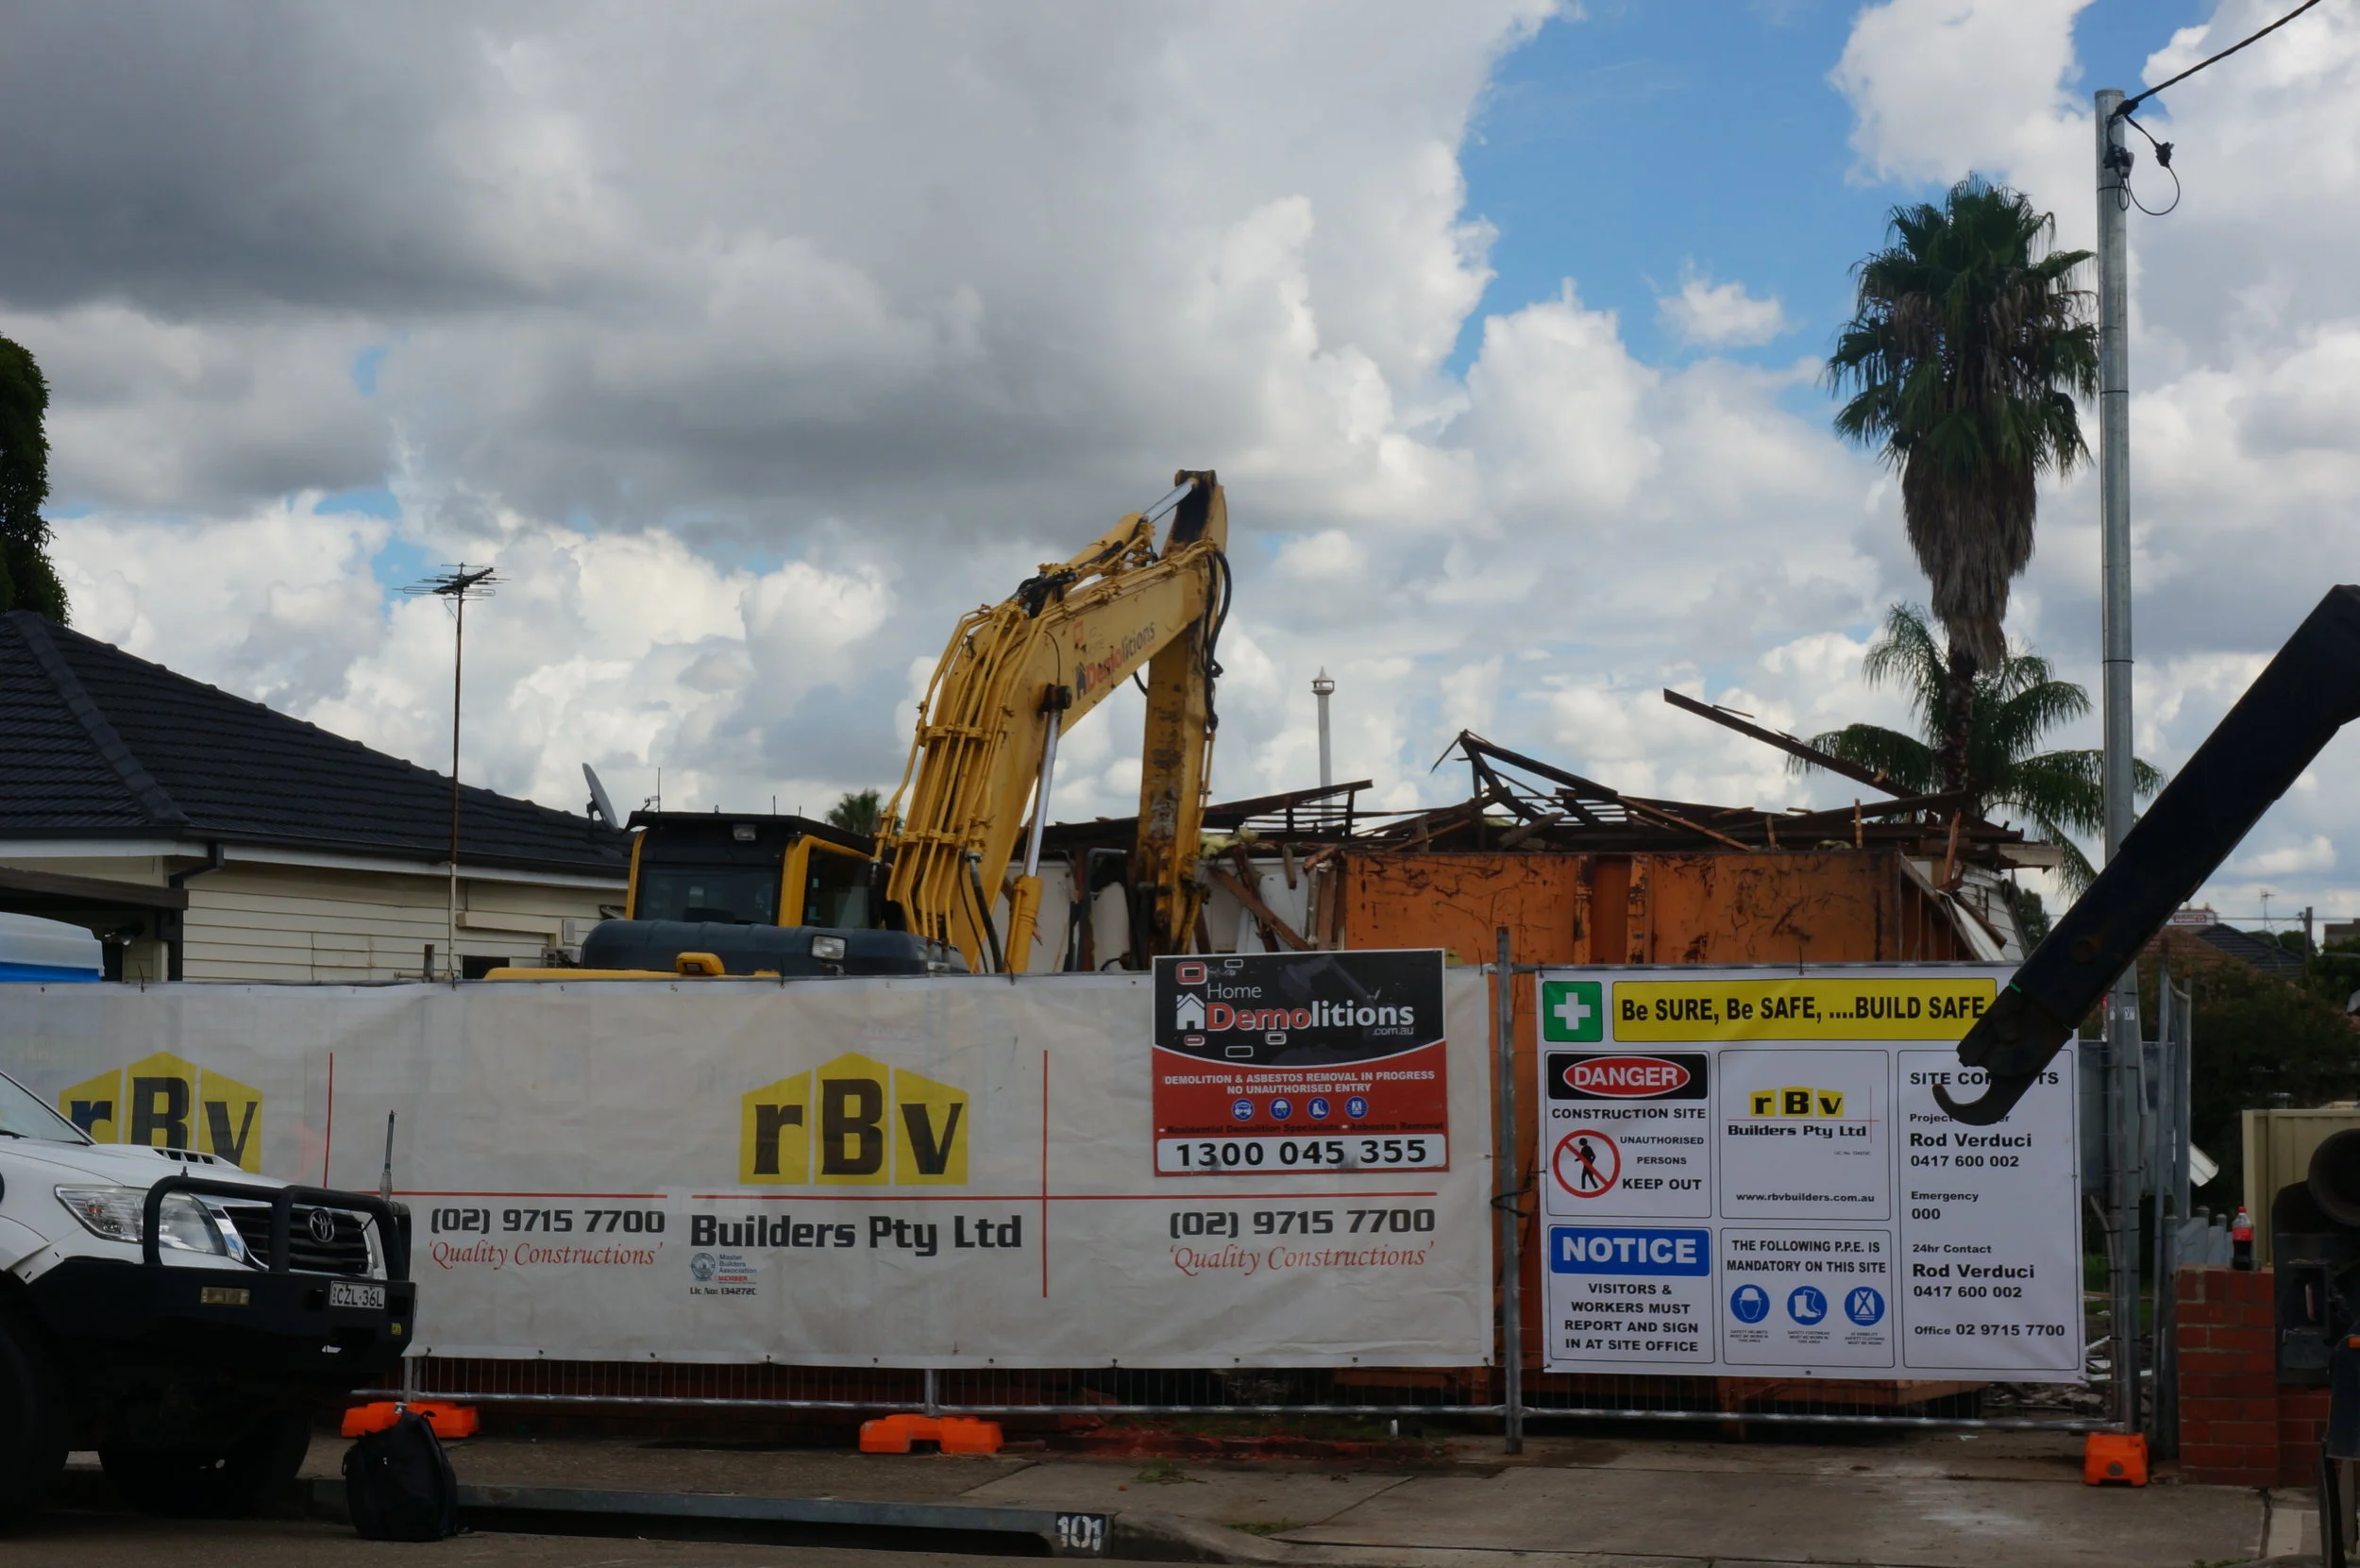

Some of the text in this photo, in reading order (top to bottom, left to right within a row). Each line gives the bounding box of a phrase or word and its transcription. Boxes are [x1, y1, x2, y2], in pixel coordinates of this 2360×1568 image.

[1207, 983, 1261, 999] Home
[1205, 1000, 1414, 1031] Demolitions
[1622, 999, 1648, 1020] Be
[1655, 998, 1720, 1025] SURE,
[1727, 997, 1754, 1020] Be
[1761, 996, 1822, 1023] SAFE,
[1929, 996, 1985, 1019] SAFE
[1373, 1026, 1413, 1036] .com.au
[1164, 1071, 1435, 1085] DEMOLITION & ASBESTOS REMOVAL IN PROGRESS
[1574, 1067, 1677, 1086] DANGER
[1910, 1072, 1951, 1085] SITE
[1227, 1083, 1372, 1094] NO UNAUTHORISED ENTRY
[1754, 1091, 1843, 1115] rBv
[1551, 1107, 1706, 1120] CONSTRUCTION SITE
[1910, 1113, 1953, 1124] Project
[753, 1078, 964, 1176] rBv
[1400, 1121, 1443, 1130] Removal
[1728, 1124, 1866, 1138] Builders Pty Ltd
[1620, 1136, 1704, 1145] UNAUTHORISED
[1910, 1133, 2031, 1147] Rod Verduci
[1176, 1139, 1426, 1167] 1300 045 355
[1637, 1156, 1687, 1165] PERSONS
[1911, 1155, 2019, 1167] 0417 600 002
[1622, 1178, 1702, 1190] KEEP OUT
[1736, 1192, 1875, 1203] www.rbvbuilders.com.au
[1911, 1190, 1979, 1203] Emergency
[1912, 1208, 1941, 1220] 000
[430, 1208, 666, 1234] (02) 9715 7700
[1170, 1208, 1435, 1239] (02) 9715 7700
[690, 1214, 1022, 1257] Builders Pty Ltd
[1562, 1237, 1697, 1263] NOTICE
[1732, 1240, 1880, 1253] THE FOLLOWING P.P.E. IS
[1913, 1243, 1992, 1254] 24hr Contact
[1727, 1260, 1886, 1273] MANDATORY ON THIS SITE
[1913, 1263, 2034, 1278] Rod Verduci
[1588, 1283, 1672, 1295] VISITORS &
[1913, 1286, 2022, 1298] 0417 600 002
[1571, 1302, 1690, 1314] WORKERS MUST
[1564, 1321, 1698, 1333] REPORT AND SIGN
[1914, 1324, 2065, 1336] Office 02 9715 7700
[1565, 1339, 1698, 1352] IN AT SITE OFFICE
[1057, 1515, 1103, 1551] 101
